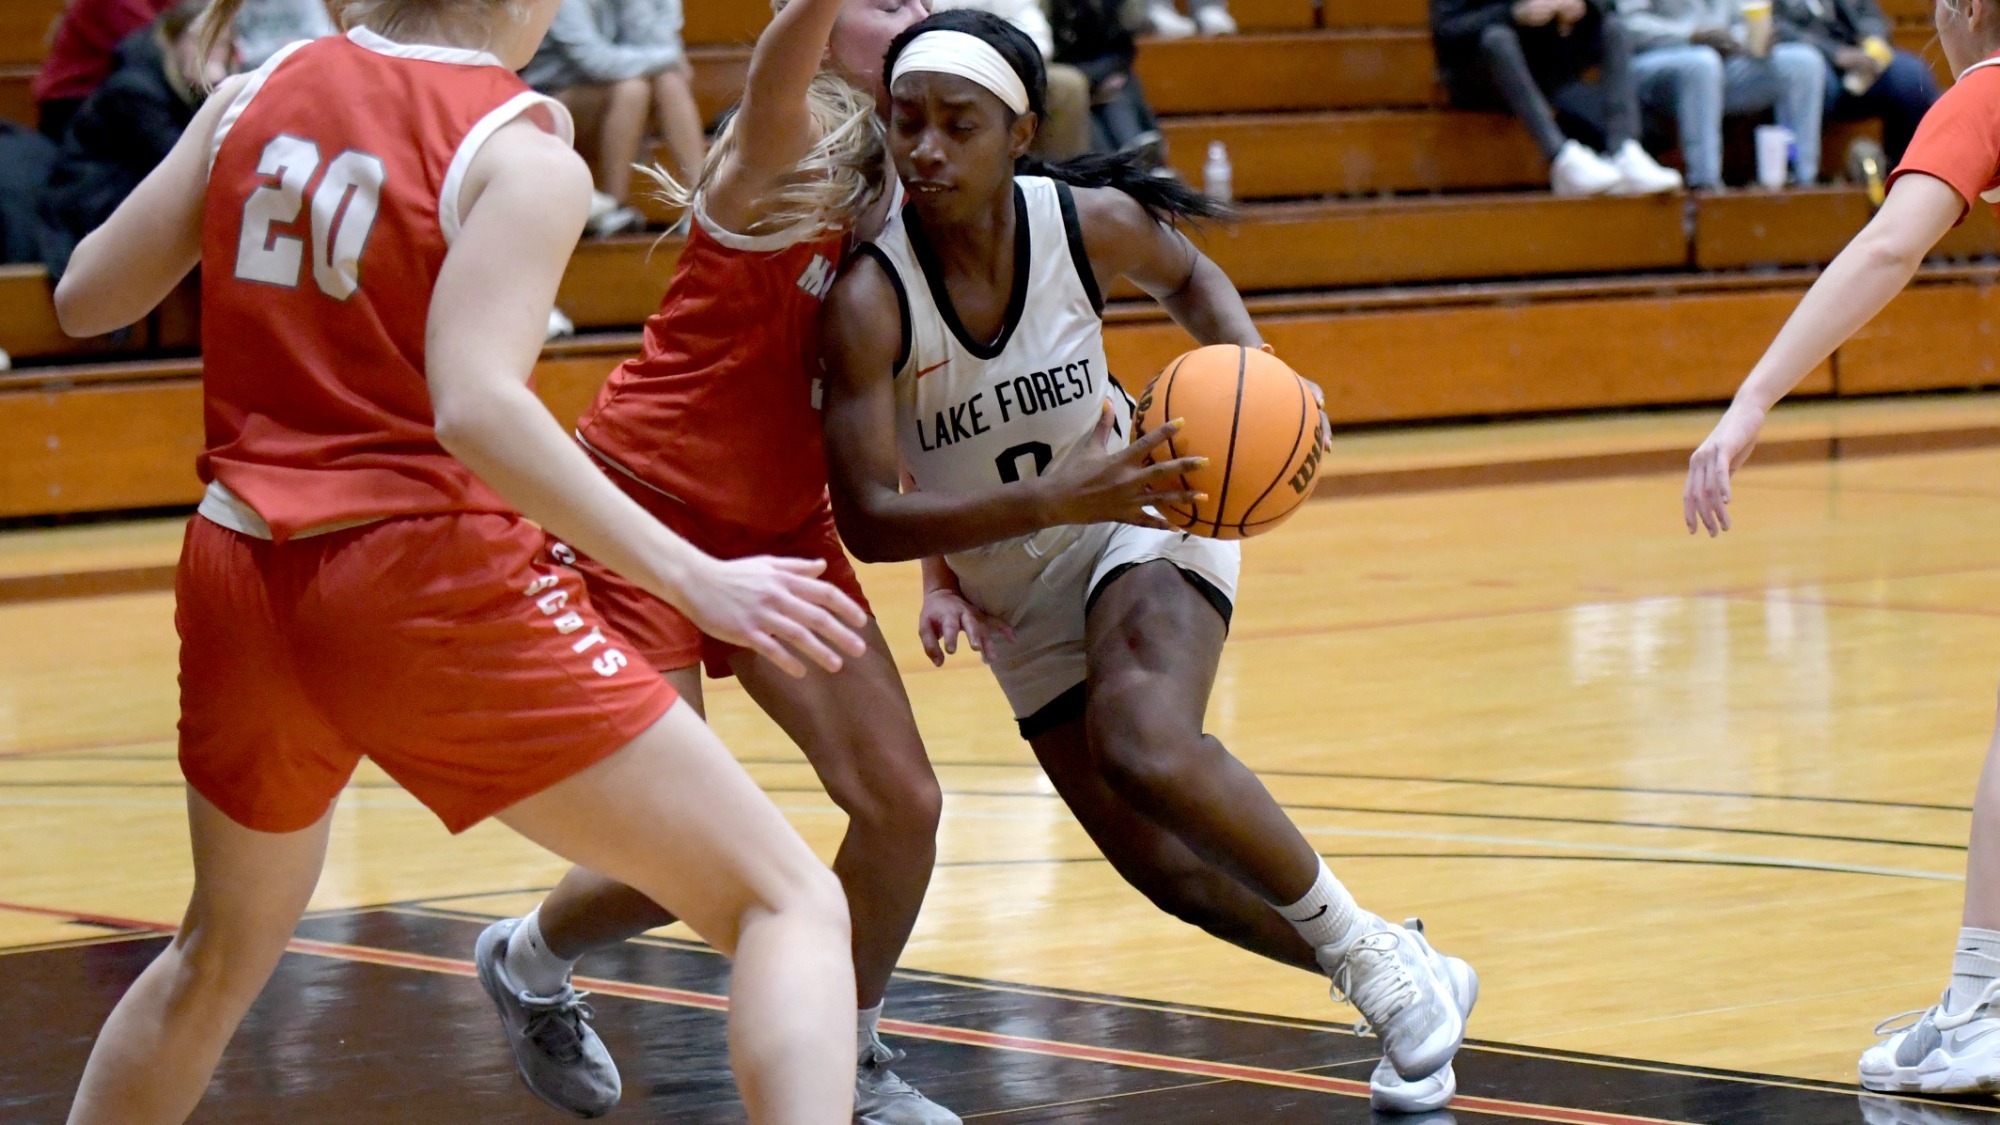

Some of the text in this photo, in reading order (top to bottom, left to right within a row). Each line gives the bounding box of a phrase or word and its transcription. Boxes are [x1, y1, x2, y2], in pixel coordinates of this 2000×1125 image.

[234, 132, 386, 301] 20
[916, 392, 991, 452] LAKE
[994, 358, 1093, 423] FOREST
